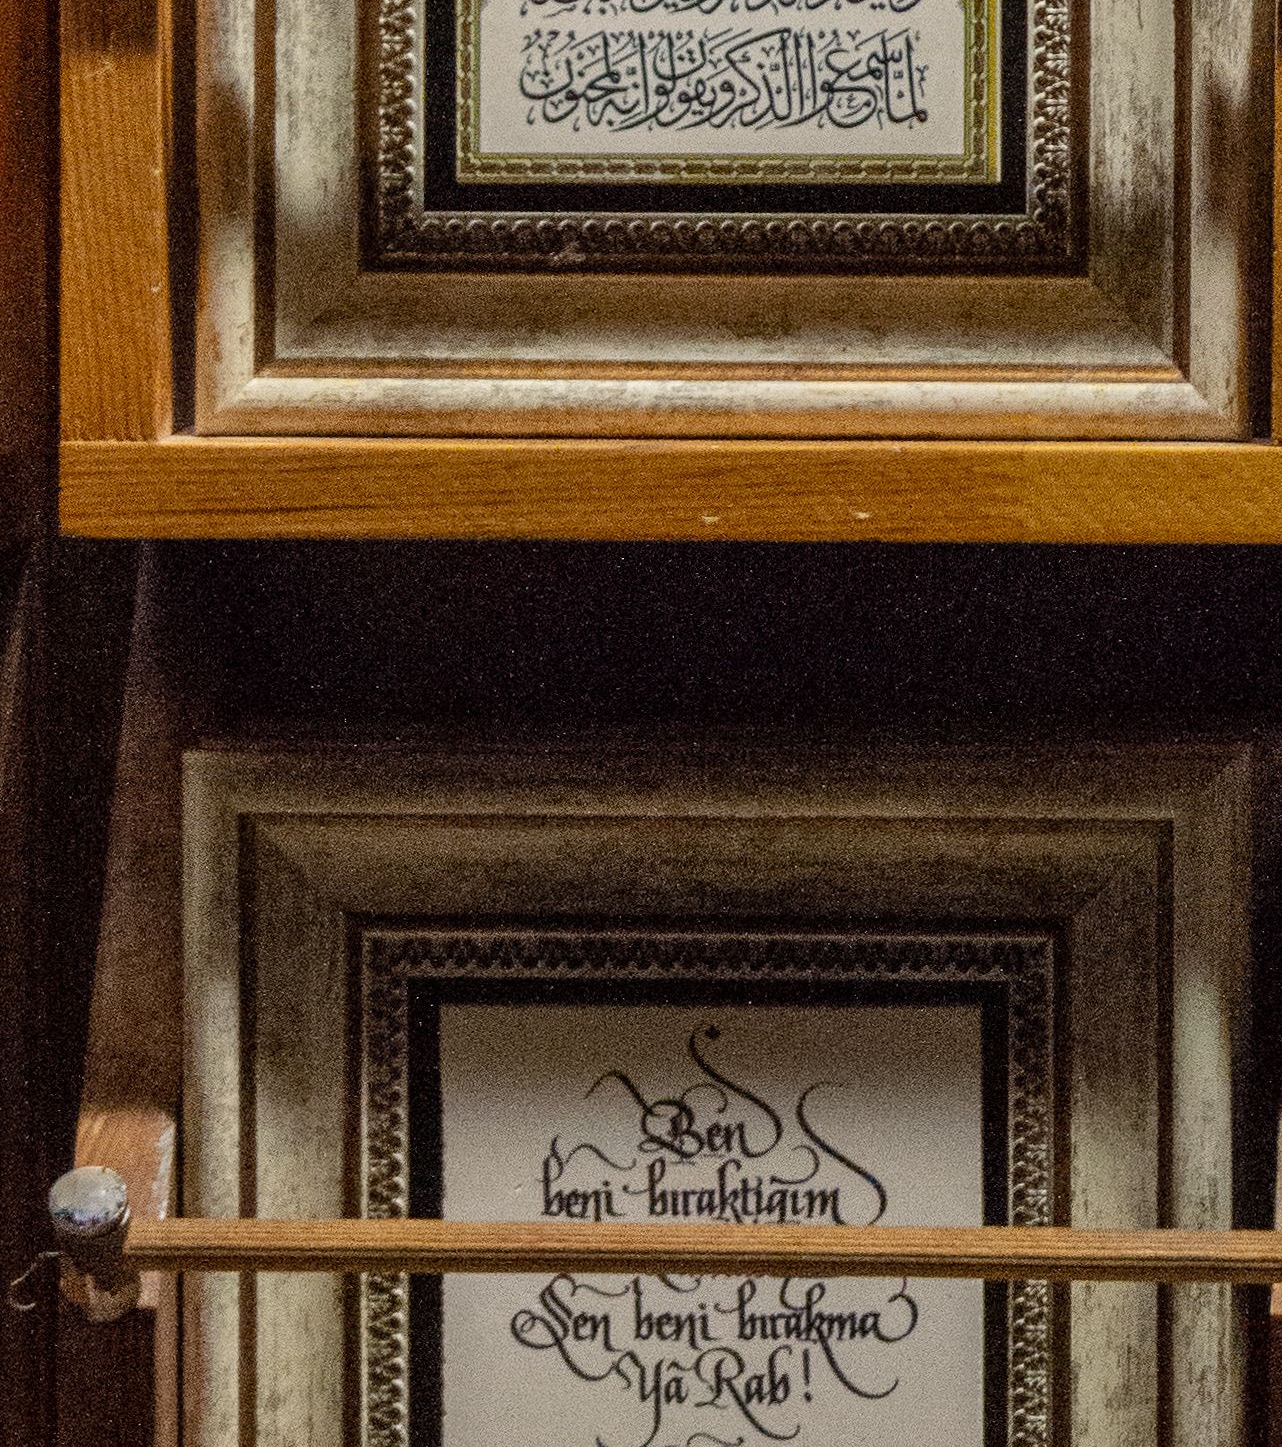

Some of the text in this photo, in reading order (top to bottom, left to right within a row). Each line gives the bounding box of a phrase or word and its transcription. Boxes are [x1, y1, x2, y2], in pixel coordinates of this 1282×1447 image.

[540, 1136, 636, 1222] beni
[510, 1274, 629, 1380] Sen
[632, 1276, 717, 1350] beni
